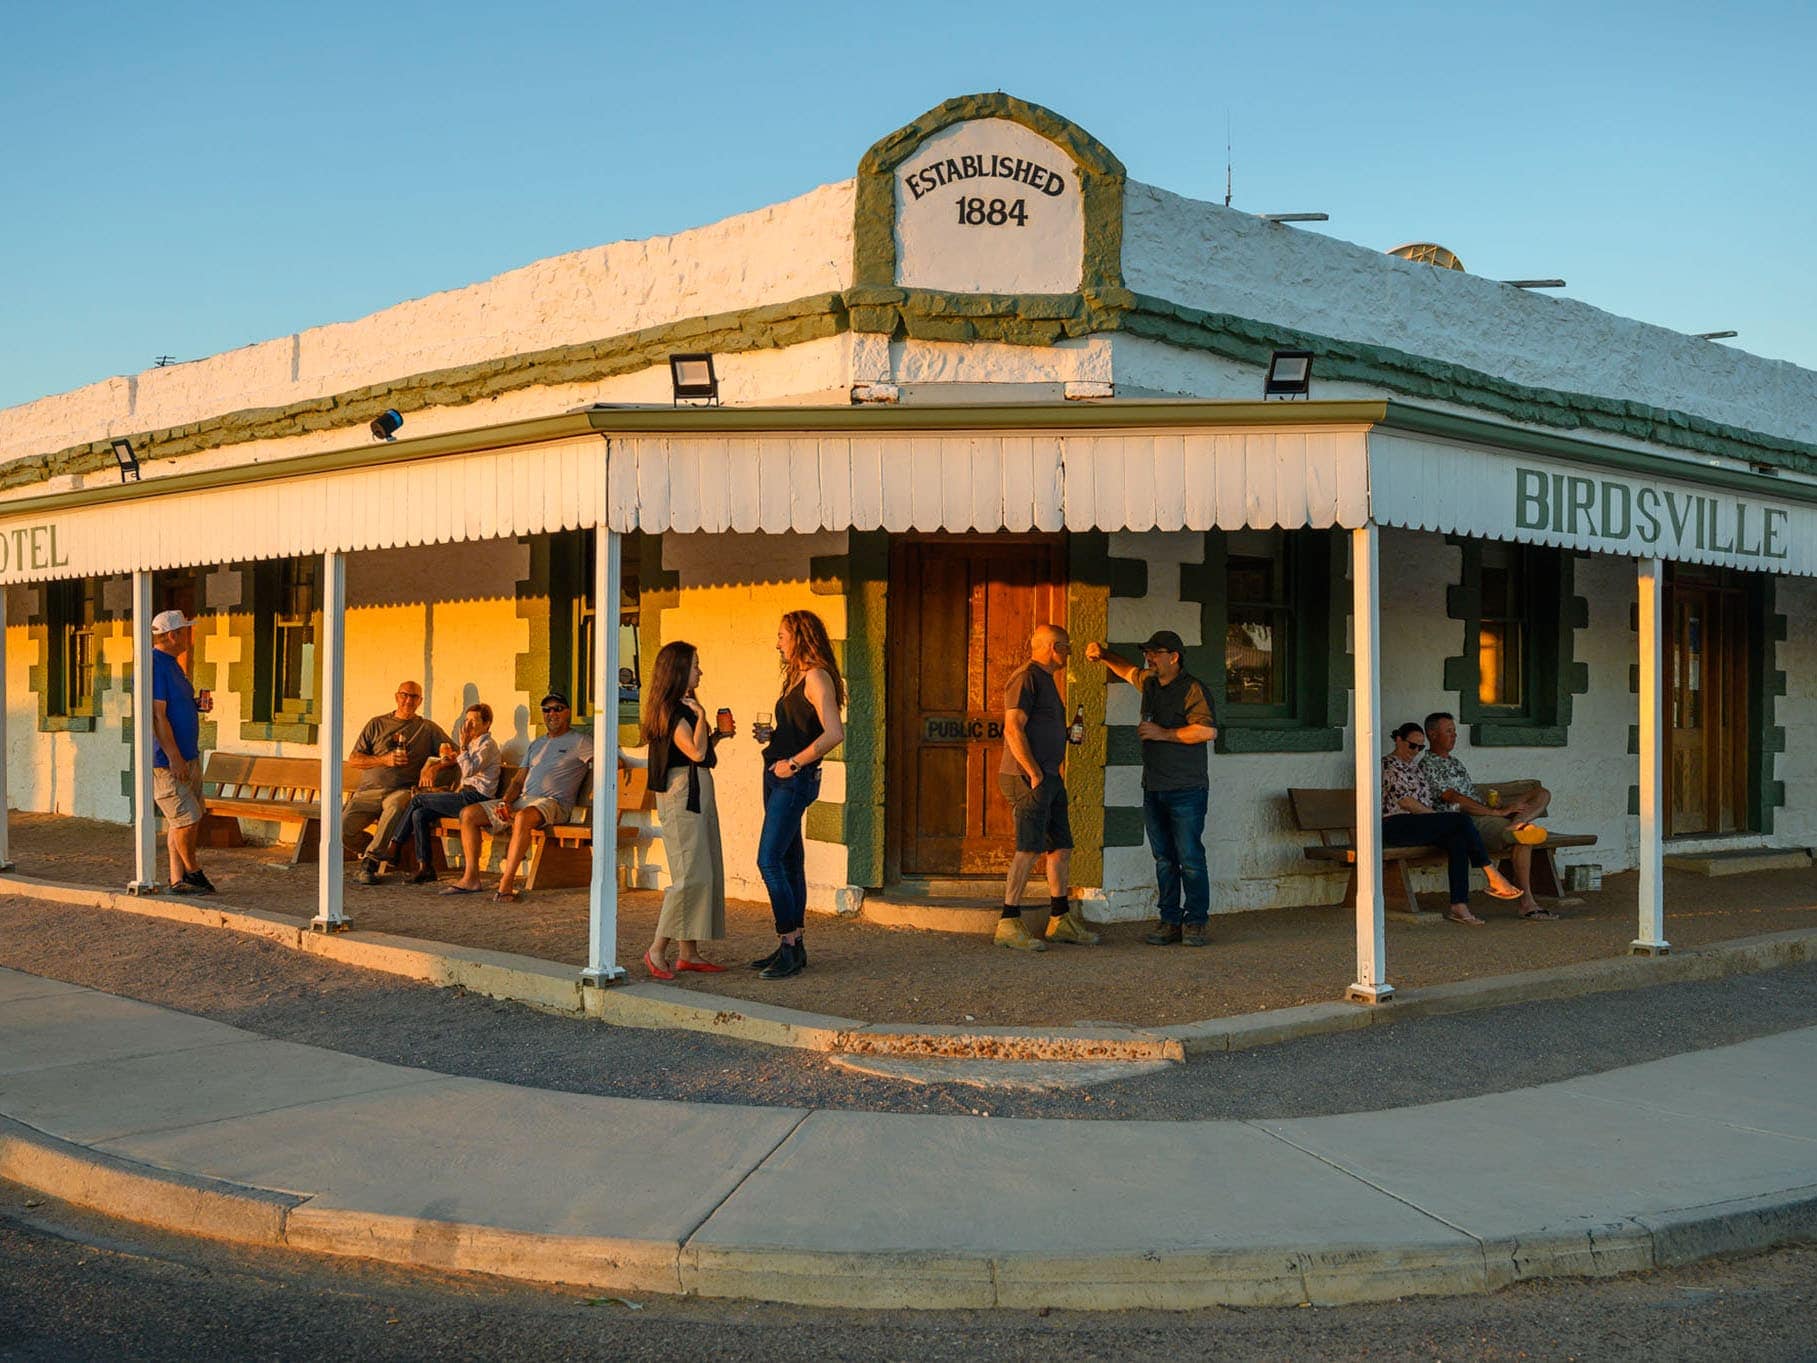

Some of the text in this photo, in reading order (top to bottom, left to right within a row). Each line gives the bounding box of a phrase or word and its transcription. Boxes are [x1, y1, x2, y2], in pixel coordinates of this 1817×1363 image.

[905, 155, 1065, 200] ESTABLISHED
[956, 196, 1028, 227] 1884
[1515, 467, 1789, 559] BIRDSVILLE
[927, 720, 983, 738] PUBLIC
